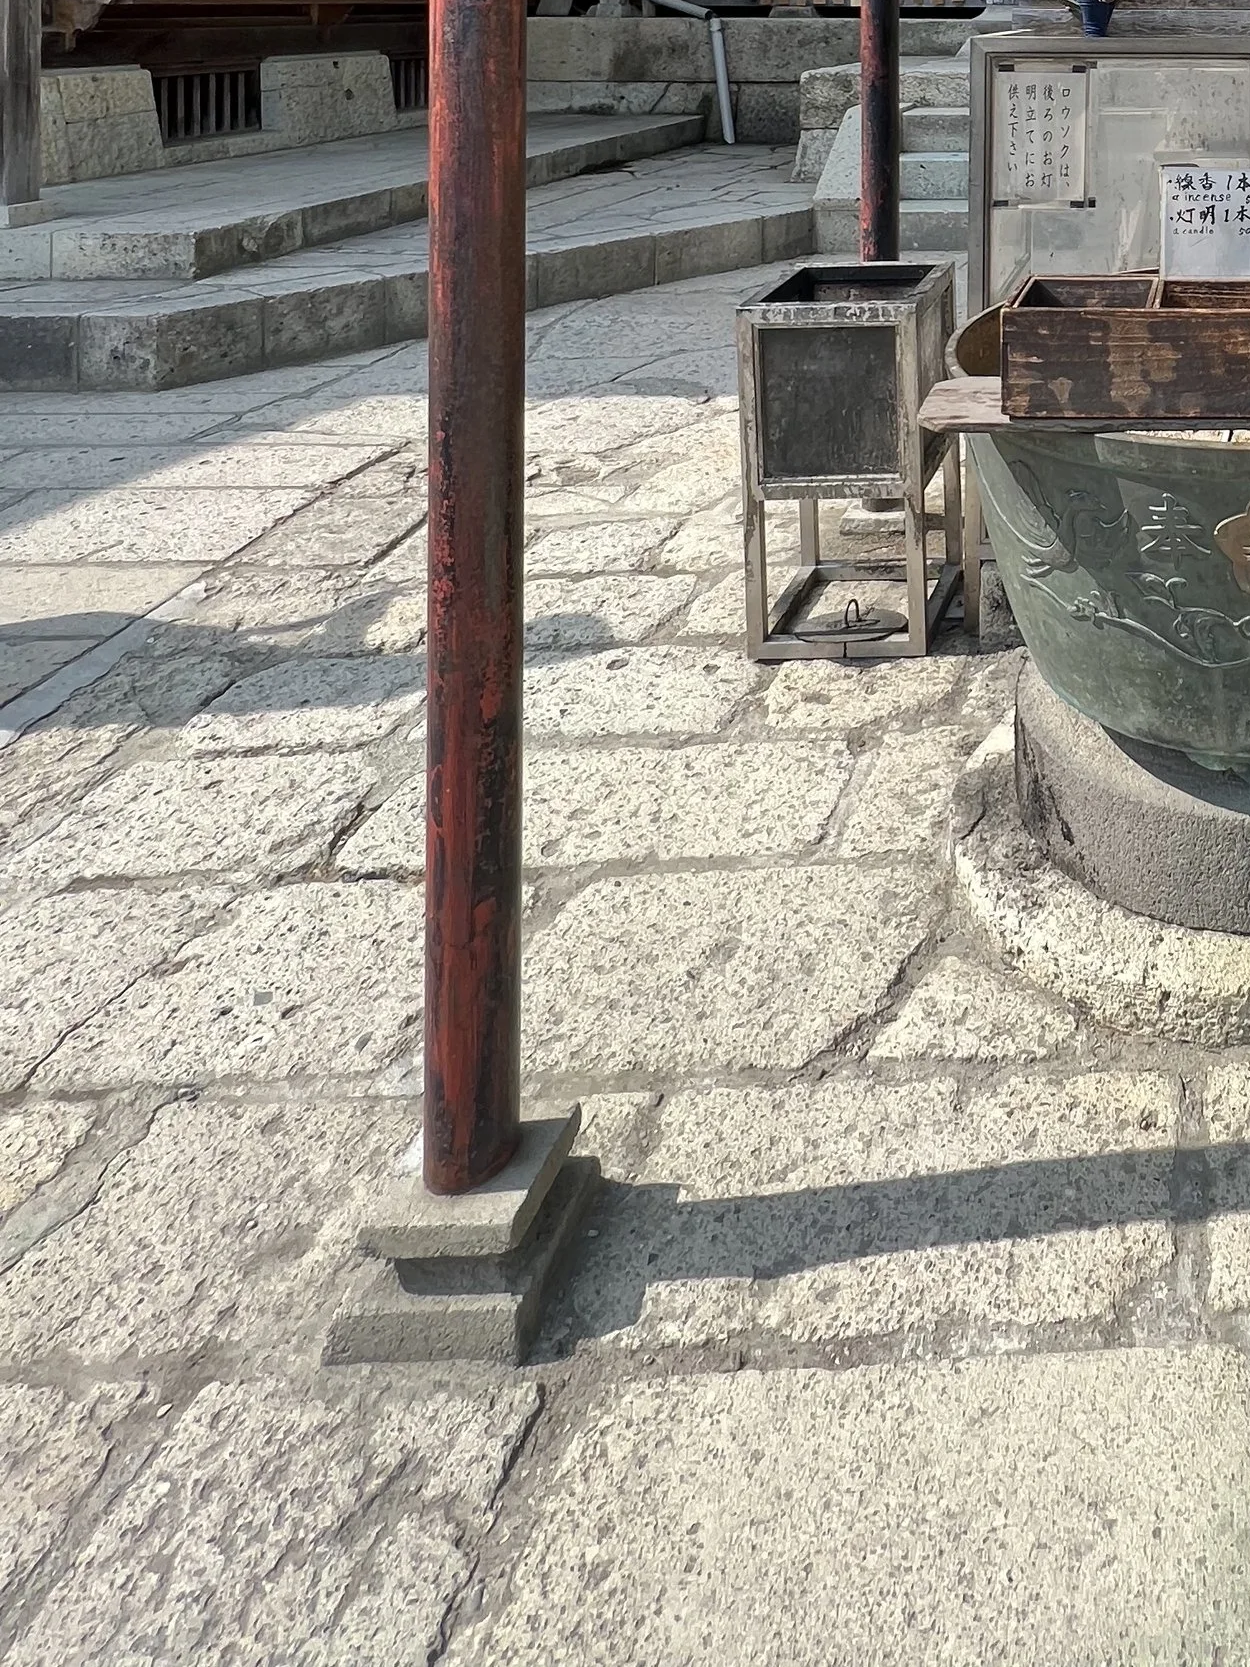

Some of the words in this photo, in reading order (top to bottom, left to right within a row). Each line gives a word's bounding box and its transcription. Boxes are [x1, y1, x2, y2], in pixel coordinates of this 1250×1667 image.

[1007, 84, 1020, 172] 供え下さい
[1025, 84, 1037, 188] 明立てにお
[1040, 84, 1055, 188] 後ろのお灯
[1060, 87, 1072, 187] ロウソクは、
[1182, 226, 1214, 235] candle
[1184, 192, 1232, 202] incense
[1139, 491, 1211, 567] 奉
